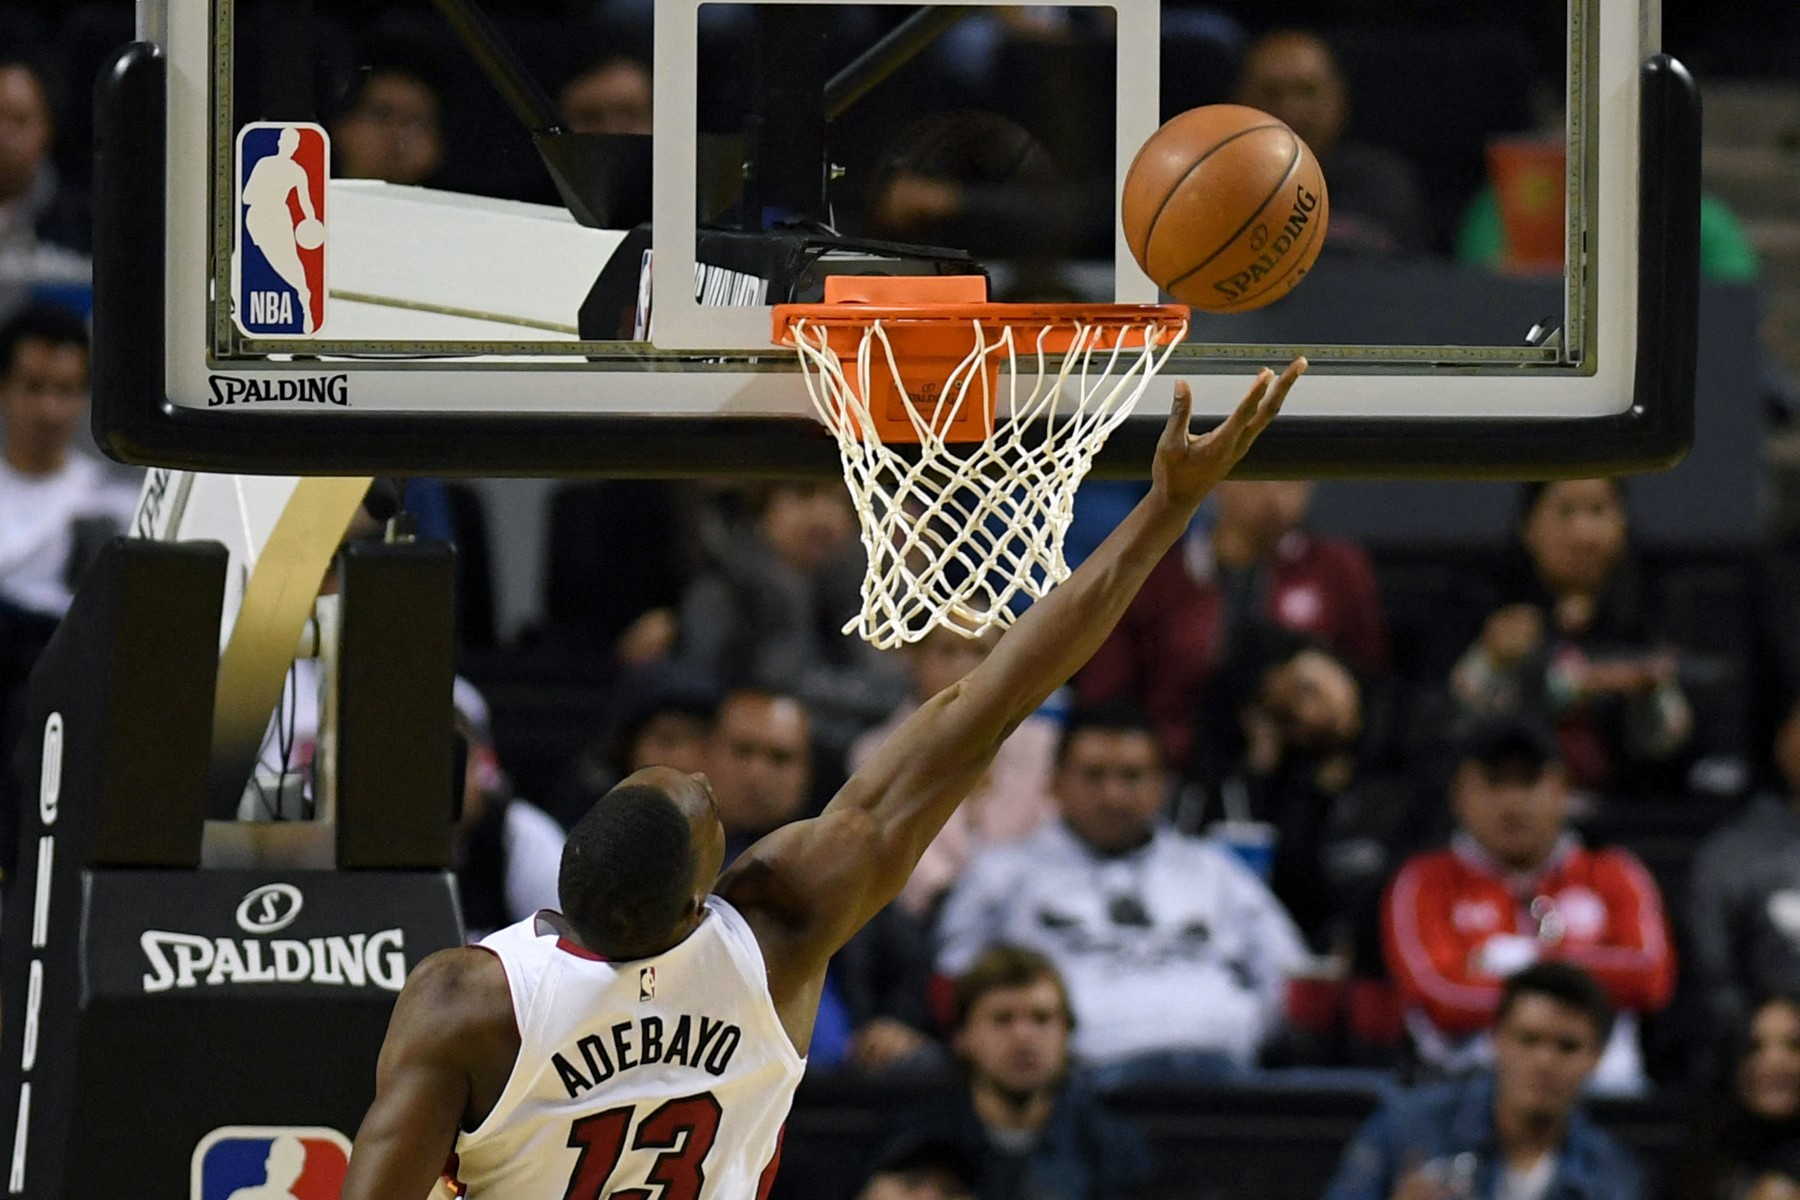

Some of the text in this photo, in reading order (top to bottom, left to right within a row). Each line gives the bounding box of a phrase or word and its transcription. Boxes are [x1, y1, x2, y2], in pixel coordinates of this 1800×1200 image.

[1213, 184, 1318, 301] SPALDING
[249, 290, 294, 325] NBA
[208, 373, 348, 407] SPALDING
[140, 928, 406, 993] SPALDING
[550, 1014, 741, 1099] ADEBAYO
[561, 1090, 723, 1200] 13
